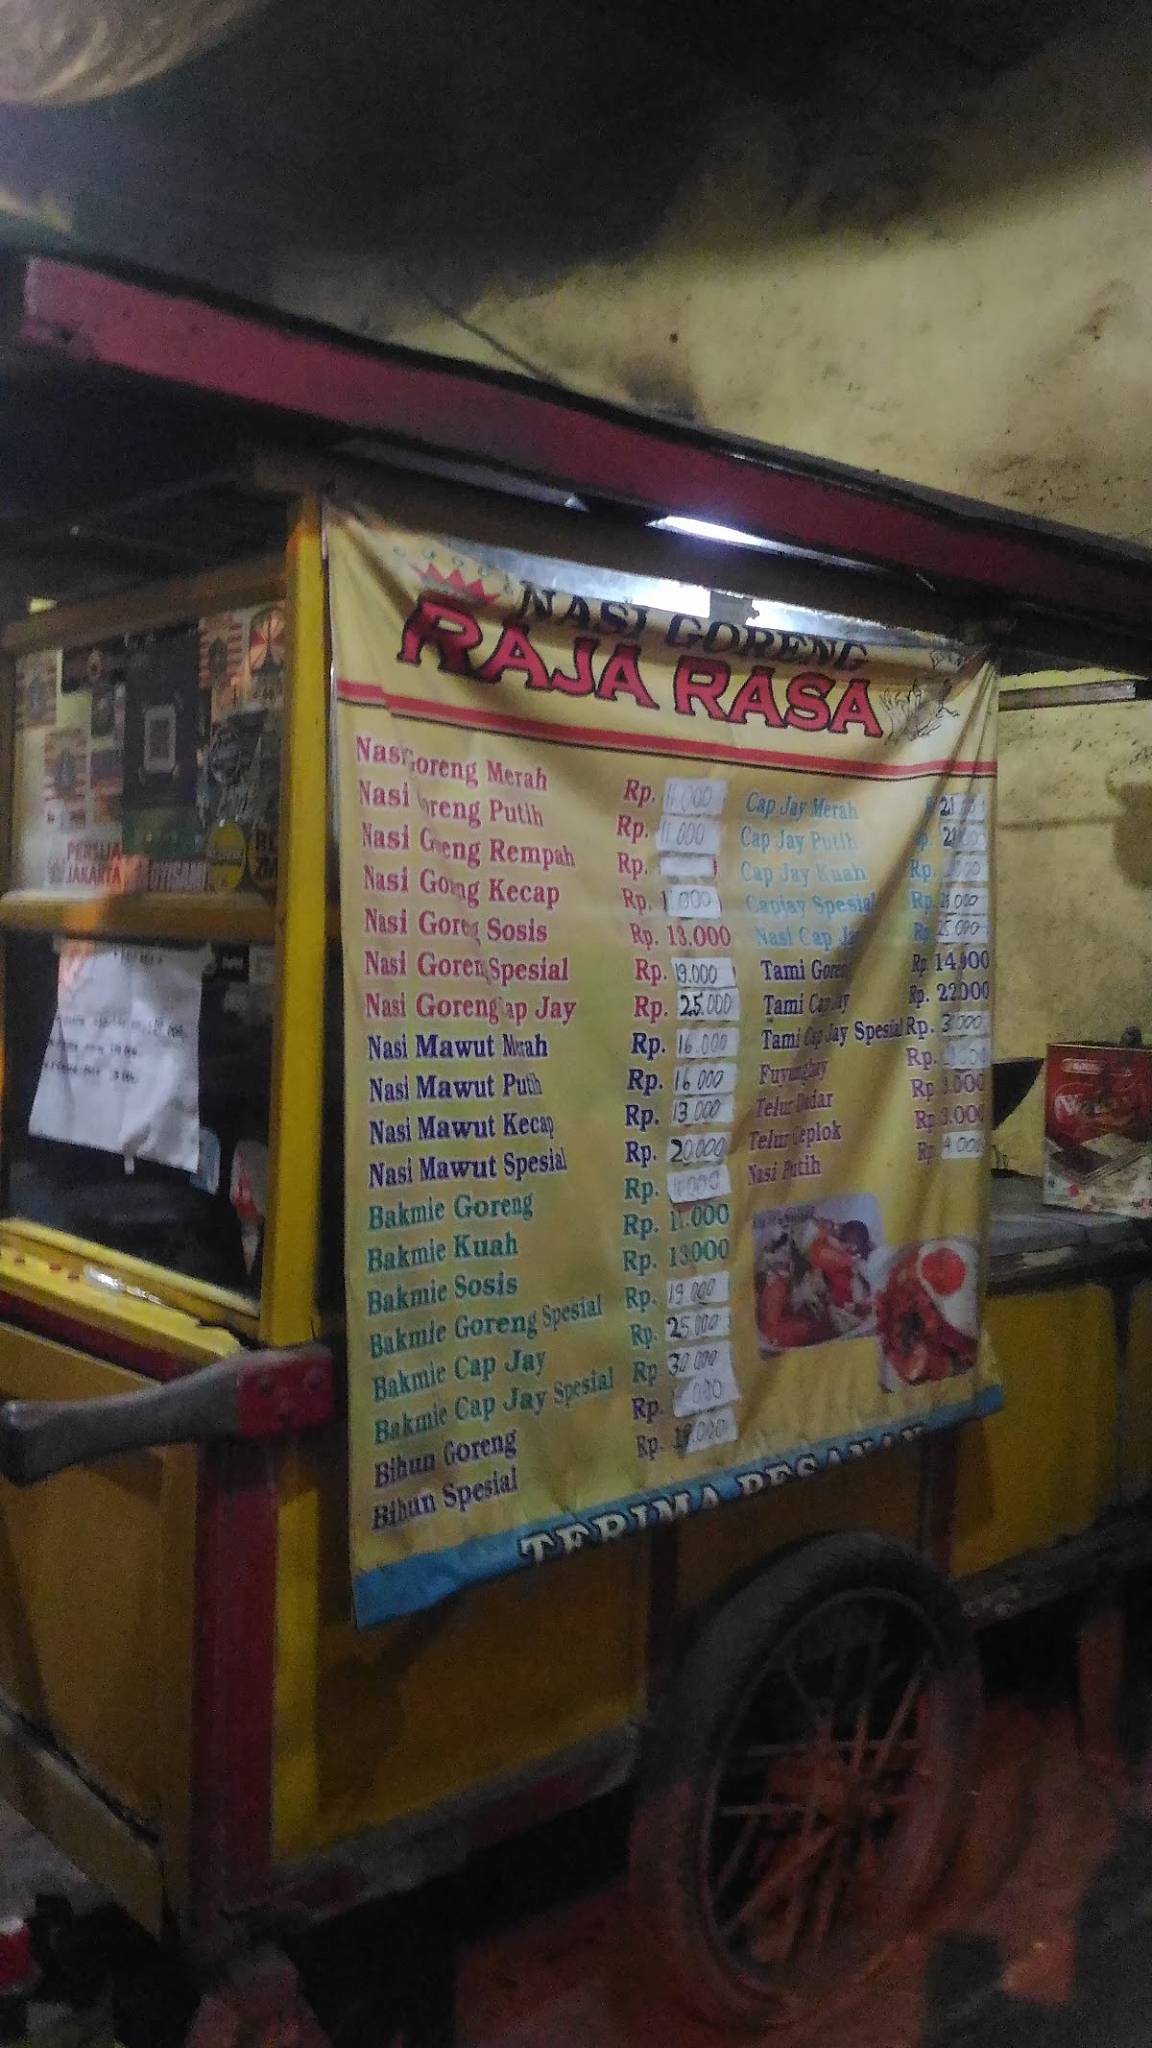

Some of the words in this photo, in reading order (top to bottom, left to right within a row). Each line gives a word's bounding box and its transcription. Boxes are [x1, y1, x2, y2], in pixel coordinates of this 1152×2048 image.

[520, 580, 648, 636] NASI
[396, 588, 660, 711] RAJA
[673, 654, 884, 738] RASA
[486, 760, 548, 791] Merah
[359, 780, 410, 807] Nasi
[416, 793, 481, 828] reng
[489, 798, 544, 827] Putih
[745, 792, 776, 818] Cap
[780, 796, 807, 821] Jay
[361, 822, 410, 850] Nasi
[489, 838, 576, 871] Rempah
[740, 825, 770, 850] Cap
[778, 830, 805, 853] Jay
[363, 864, 409, 893] Nasi
[489, 878, 560, 909] Kecap
[740, 861, 773, 887] Cap
[780, 863, 809, 887] Jay
[365, 908, 407, 935] Nasi
[487, 917, 548, 943] Sosis
[667, 924, 731, 947] 13.000
[799, 926, 833, 951] Cap
[364, 950, 407, 976] Nasi
[488, 957, 569, 987] Spesial
[634, 958, 668, 986] Rp.
[761, 959, 805, 981] Tami
[365, 992, 407, 1018] Nasi
[416, 992, 500, 1025] Goreng
[502, 998, 528, 1026] ap
[535, 995, 577, 1026] Jay
[633, 995, 668, 1024] Rp.
[764, 993, 804, 1015] Tami
[762, 1029, 801, 1050] Tami
[907, 1016, 935, 1040] Rp.
[367, 1033, 408, 1061] Nasi
[415, 1034, 495, 1058] Mawut
[631, 1032, 666, 1060] Rp.
[369, 1076, 410, 1103] Nasi
[416, 1073, 495, 1100] Mawut
[626, 1069, 664, 1096] Rp.
[369, 1116, 412, 1145] Nasi
[417, 1115, 496, 1141] Mawut
[503, 1111, 554, 1140] Kecap
[625, 1104, 660, 1132] Rp.
[369, 1156, 413, 1189] Nasi
[419, 1154, 497, 1182] Mawut
[504, 1147, 568, 1181] Spesial
[625, 1140, 657, 1168] Rp.
[625, 1177, 659, 1205] Rp.
[369, 1196, 445, 1231] Bakmie
[454, 1193, 534, 1221] Goreng
[623, 1213, 660, 1241] Rp.
[367, 1238, 447, 1273] Bakmie
[454, 1231, 519, 1259] Kuah
[623, 1249, 657, 1277] Rp.
[367, 1279, 448, 1316] Bakmie
[455, 1273, 519, 1299] Sosis
[625, 1286, 657, 1313] Rp.
[370, 1320, 447, 1360] Bakmie
[455, 1309, 539, 1340] Goreng
[542, 1294, 604, 1331] Spesial
[372, 1361, 447, 1402] Bakmie
[455, 1355, 496, 1382] Cap
[504, 1349, 546, 1376] Jay
[374, 1404, 448, 1445] Bakmie
[455, 1396, 496, 1422] Cap
[503, 1387, 548, 1416] Jay
[554, 1367, 615, 1407] Spesial
[374, 1453, 436, 1489] Bihun
[444, 1429, 517, 1466] Goreng
[373, 1492, 437, 1531] Bihun
[442, 1465, 519, 1512] Spesial
